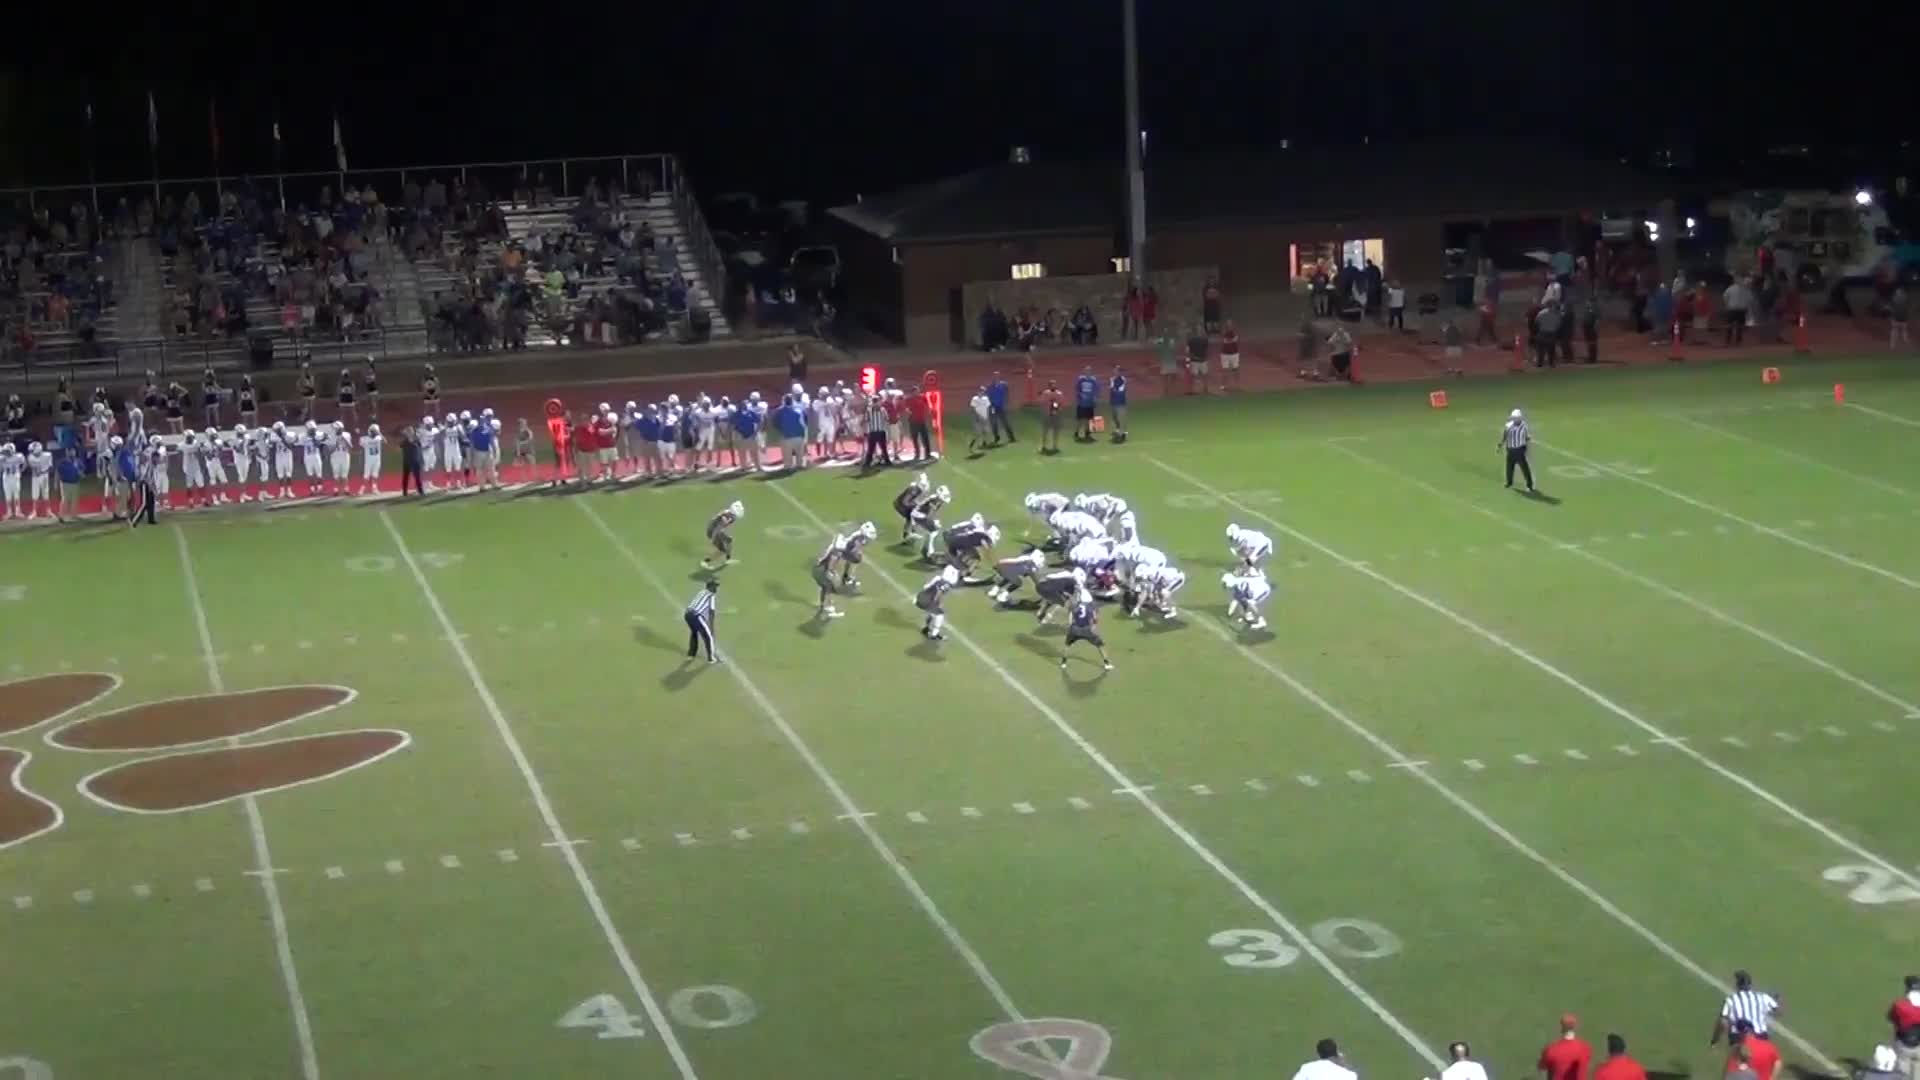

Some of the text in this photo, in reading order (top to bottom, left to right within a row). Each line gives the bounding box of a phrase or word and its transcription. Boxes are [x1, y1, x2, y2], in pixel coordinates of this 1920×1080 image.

[862, 367, 877, 391] 3
[1078, 603, 1087, 619] 3
[1207, 918, 1403, 969] 30
[553, 984, 765, 1039] 40
